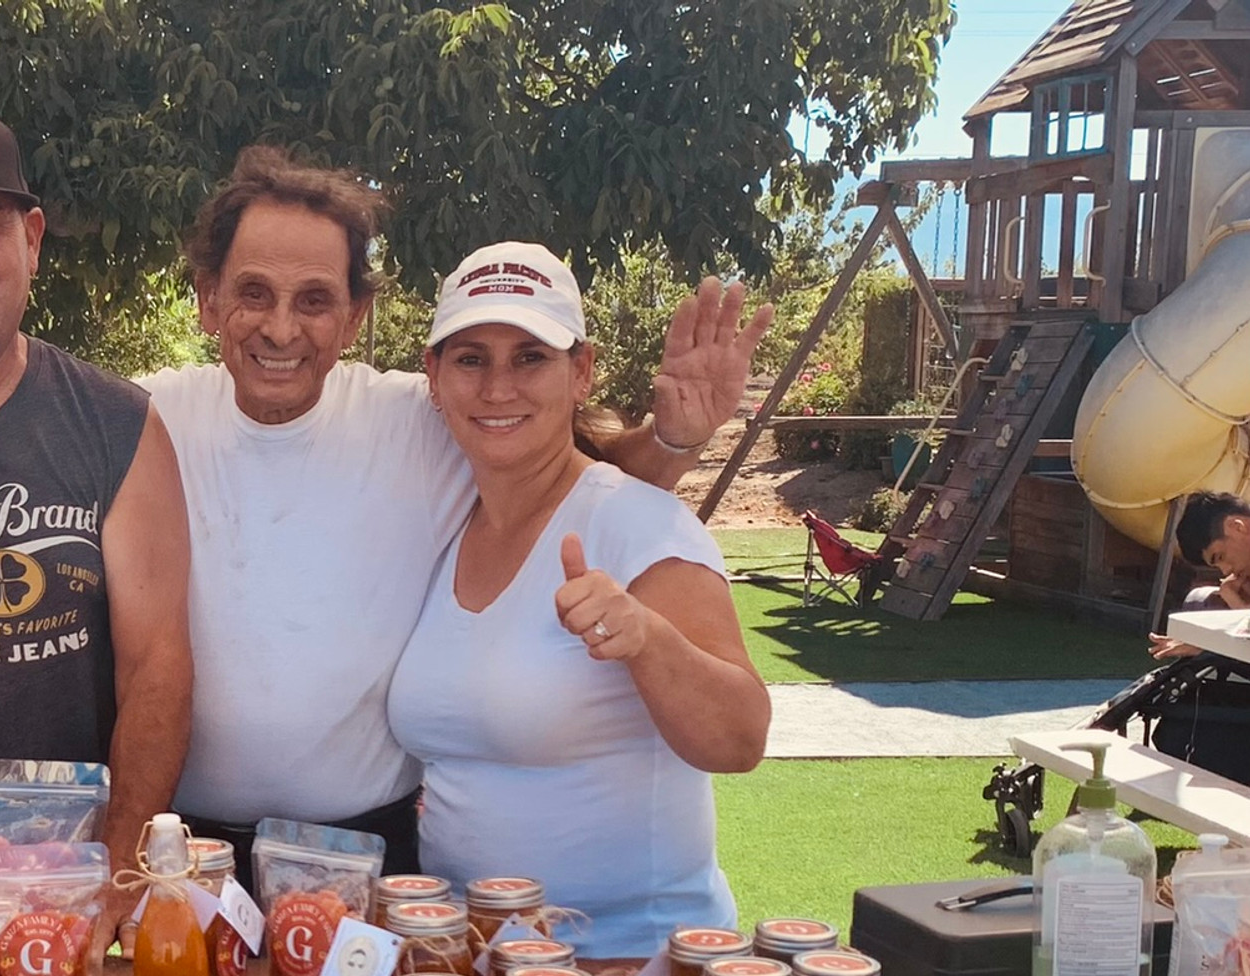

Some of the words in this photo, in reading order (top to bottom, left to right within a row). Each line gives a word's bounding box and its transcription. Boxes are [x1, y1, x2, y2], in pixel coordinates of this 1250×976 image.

[488, 285, 514, 293] MOM
[56, 562, 72, 576] LOS
[69, 579, 84, 593] CA
[17, 610, 78, 634] FAVORITE
[8, 627, 89, 662] JEANS
[286, 925, 313, 962] G
[20, 939, 53, 976] G
